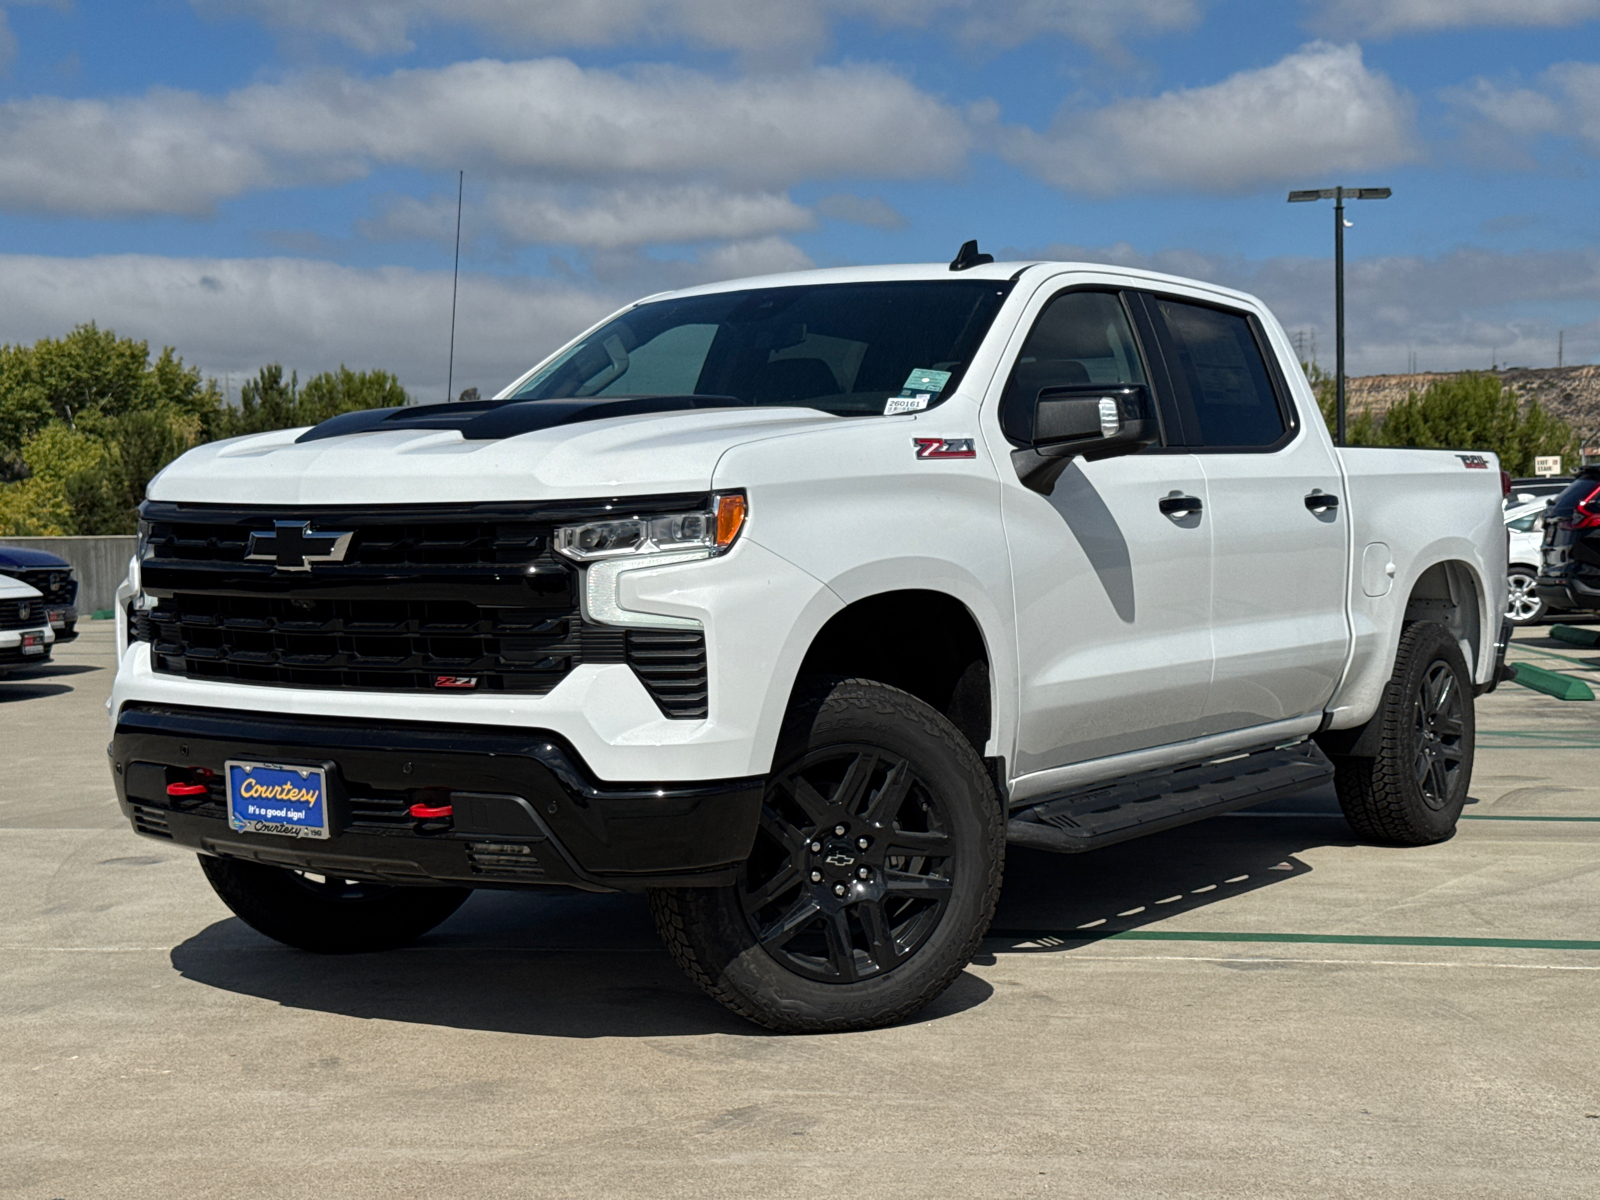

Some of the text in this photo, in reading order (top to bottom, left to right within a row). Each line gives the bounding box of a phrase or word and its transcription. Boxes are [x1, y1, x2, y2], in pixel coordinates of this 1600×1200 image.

[888, 400, 921, 408] 260161
[435, 676, 478, 687] Z71
[240, 778, 319, 808] Courtesy
[248, 804, 260, 815] It's
[266, 807, 287, 819] good
[287, 808, 306, 821] sign!
[254, 820, 302, 837] Courtesy
